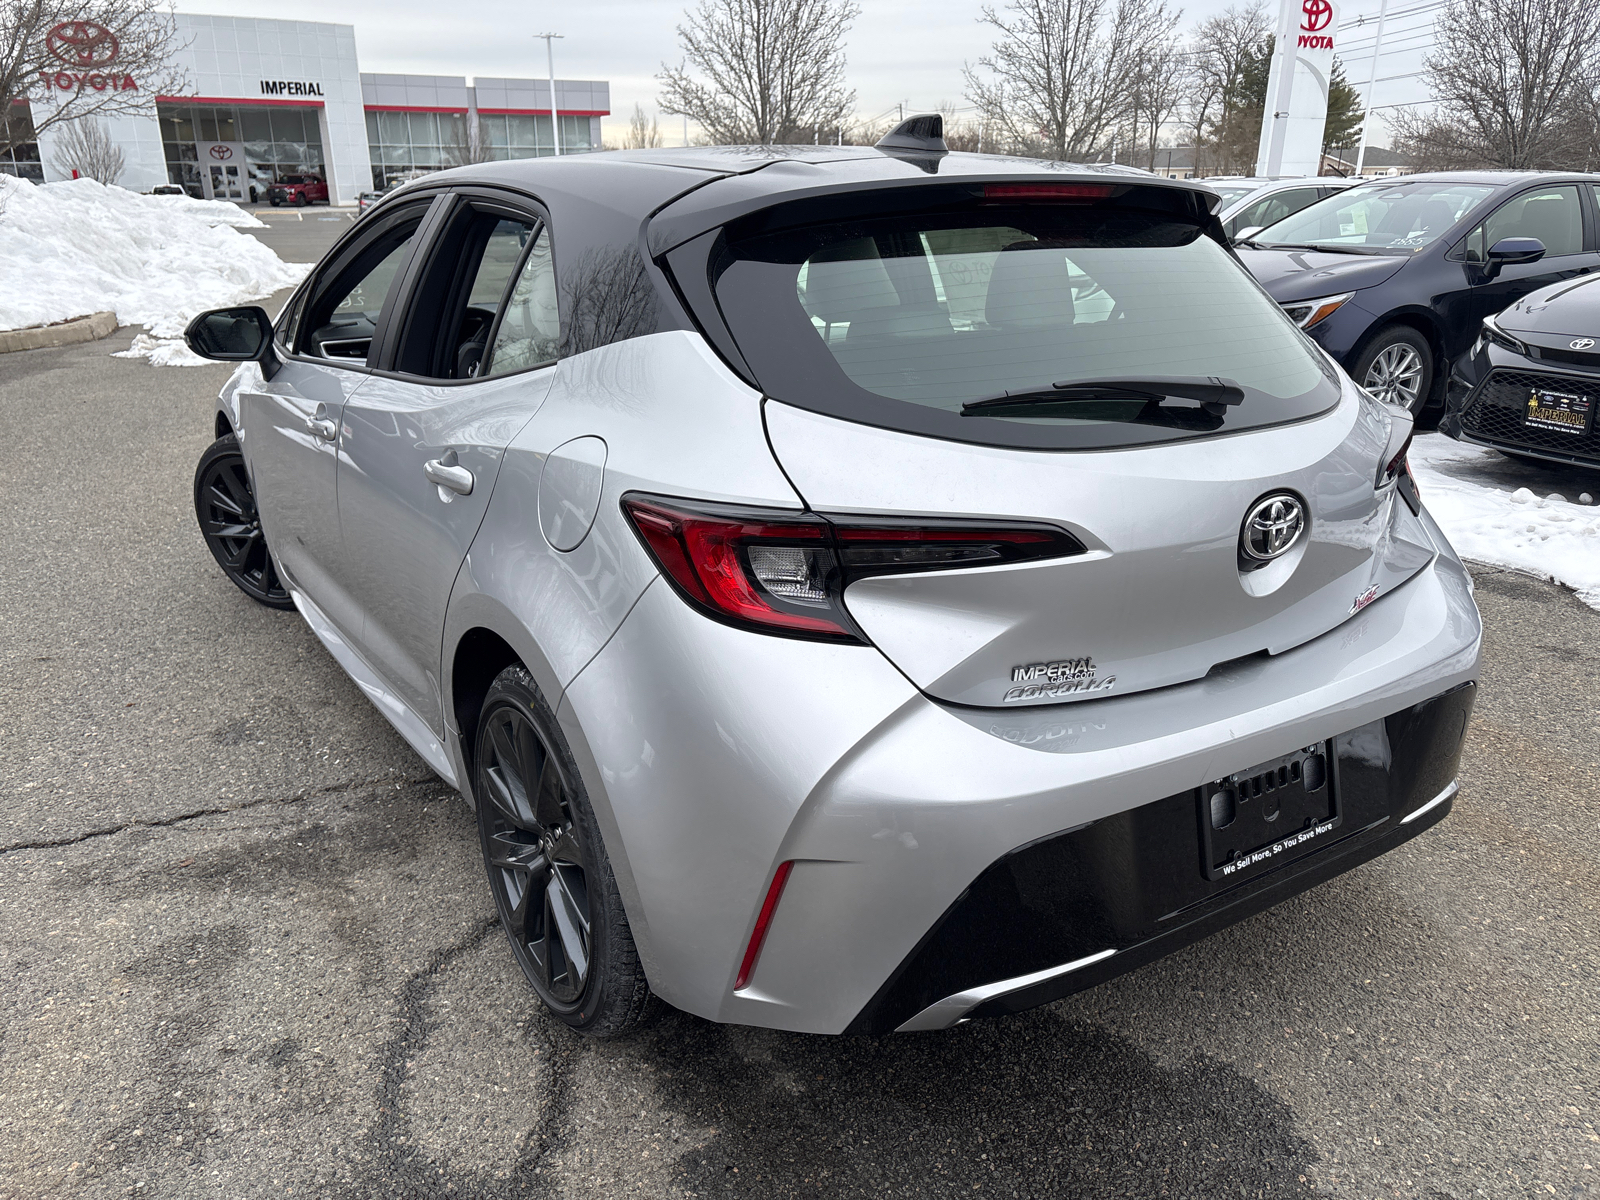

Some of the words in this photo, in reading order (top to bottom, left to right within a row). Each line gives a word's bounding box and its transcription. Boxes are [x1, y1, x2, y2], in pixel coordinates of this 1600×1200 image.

[39, 71, 139, 91] TOYOTA
[260, 80, 324, 96] IMPERIAL
[1528, 406, 1586, 425] IMPERIAL
[1011, 657, 1097, 681] IMPERIAL
[1051, 670, 1096, 683] cars.com
[1003, 675, 1117, 702] COROLLA
[1223, 865, 1236, 876] We
[1236, 859, 1251, 871] Sell
[1251, 849, 1272, 864] More,
[1272, 844, 1283, 854] So
[1283, 839, 1297, 849] You
[1297, 830, 1315, 843] Save
[1315, 822, 1333, 835] More
